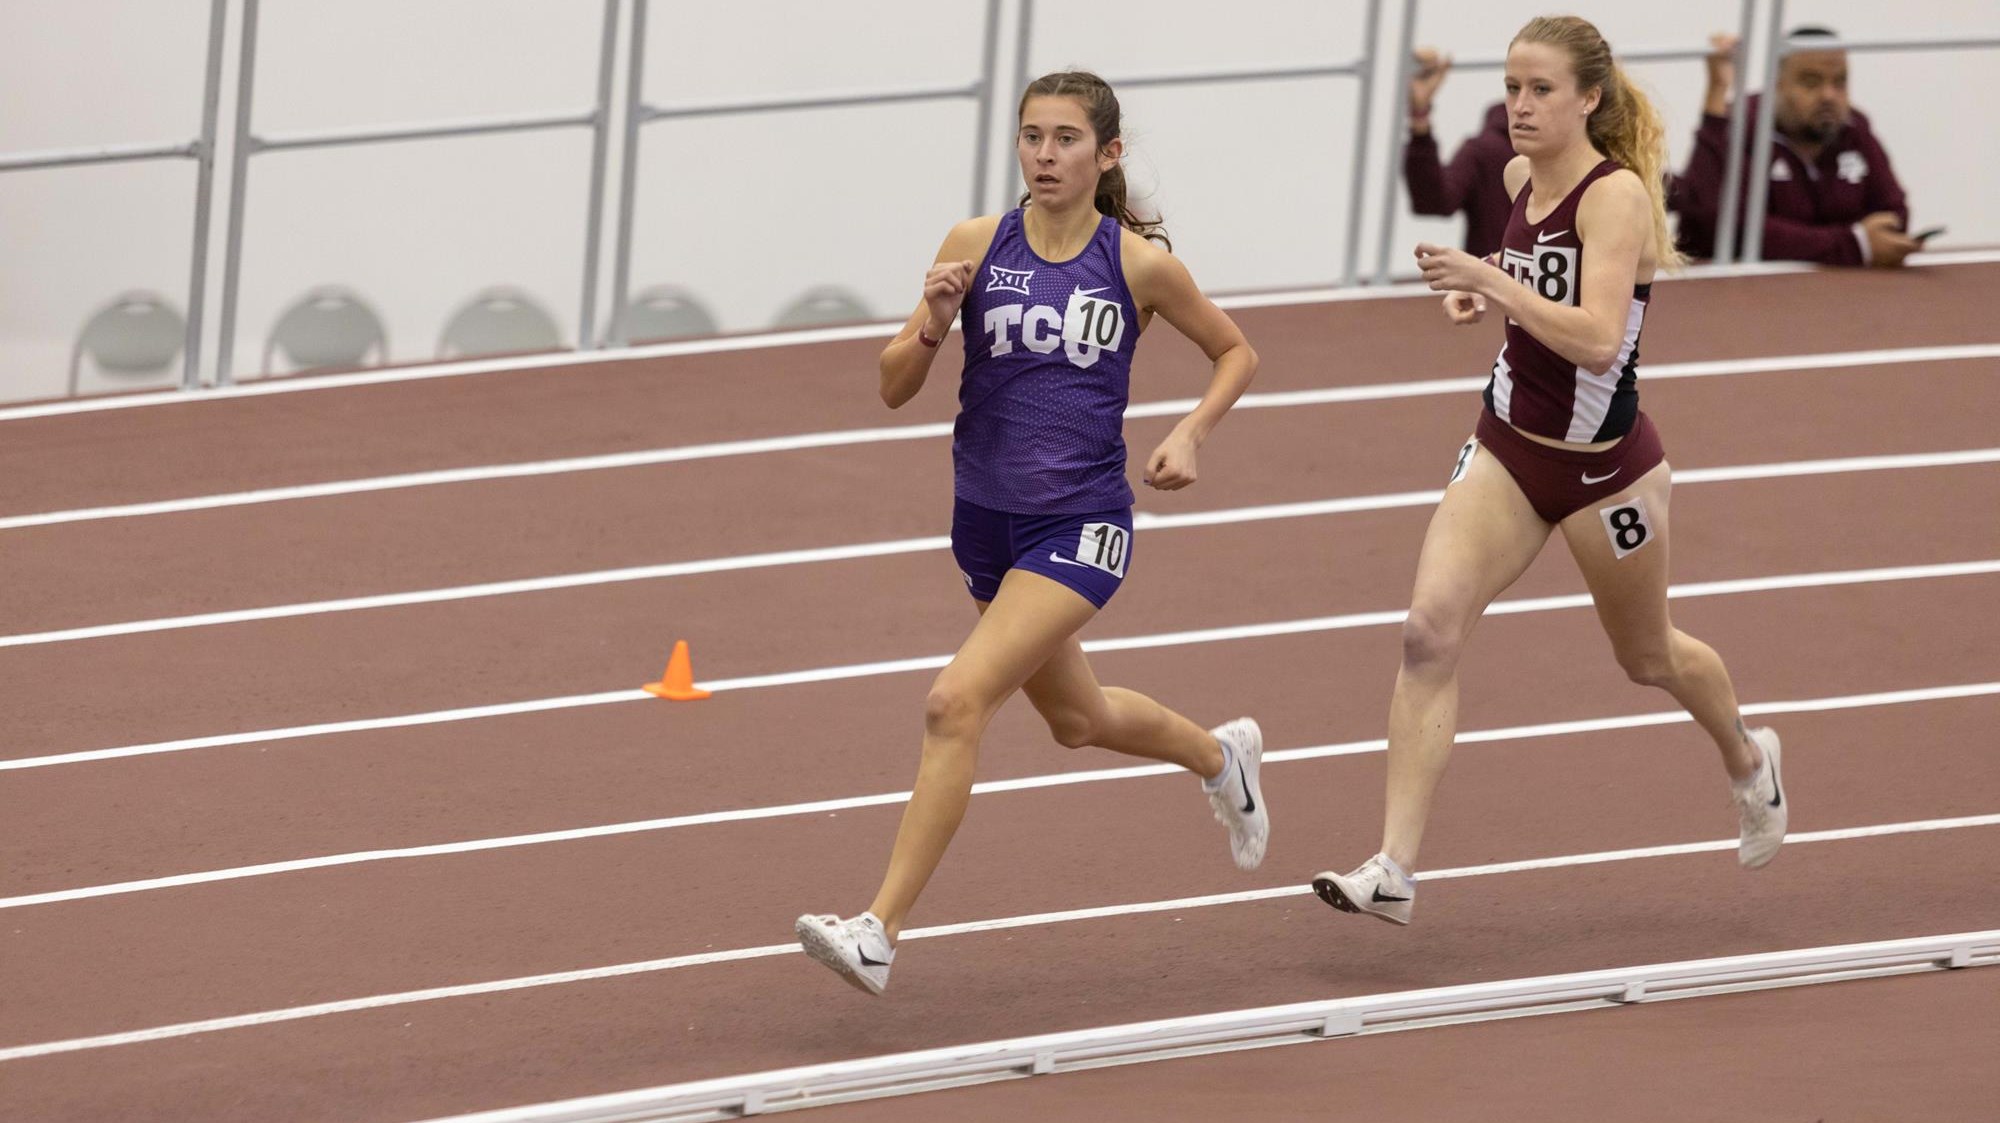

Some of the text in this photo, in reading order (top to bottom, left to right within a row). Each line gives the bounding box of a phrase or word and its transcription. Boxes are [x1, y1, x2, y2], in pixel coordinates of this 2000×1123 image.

[1538, 252, 1568, 302] 8
[1080, 300, 1119, 346] 10
[1094, 525, 1123, 571] 10
[1609, 507, 1646, 550] 8
